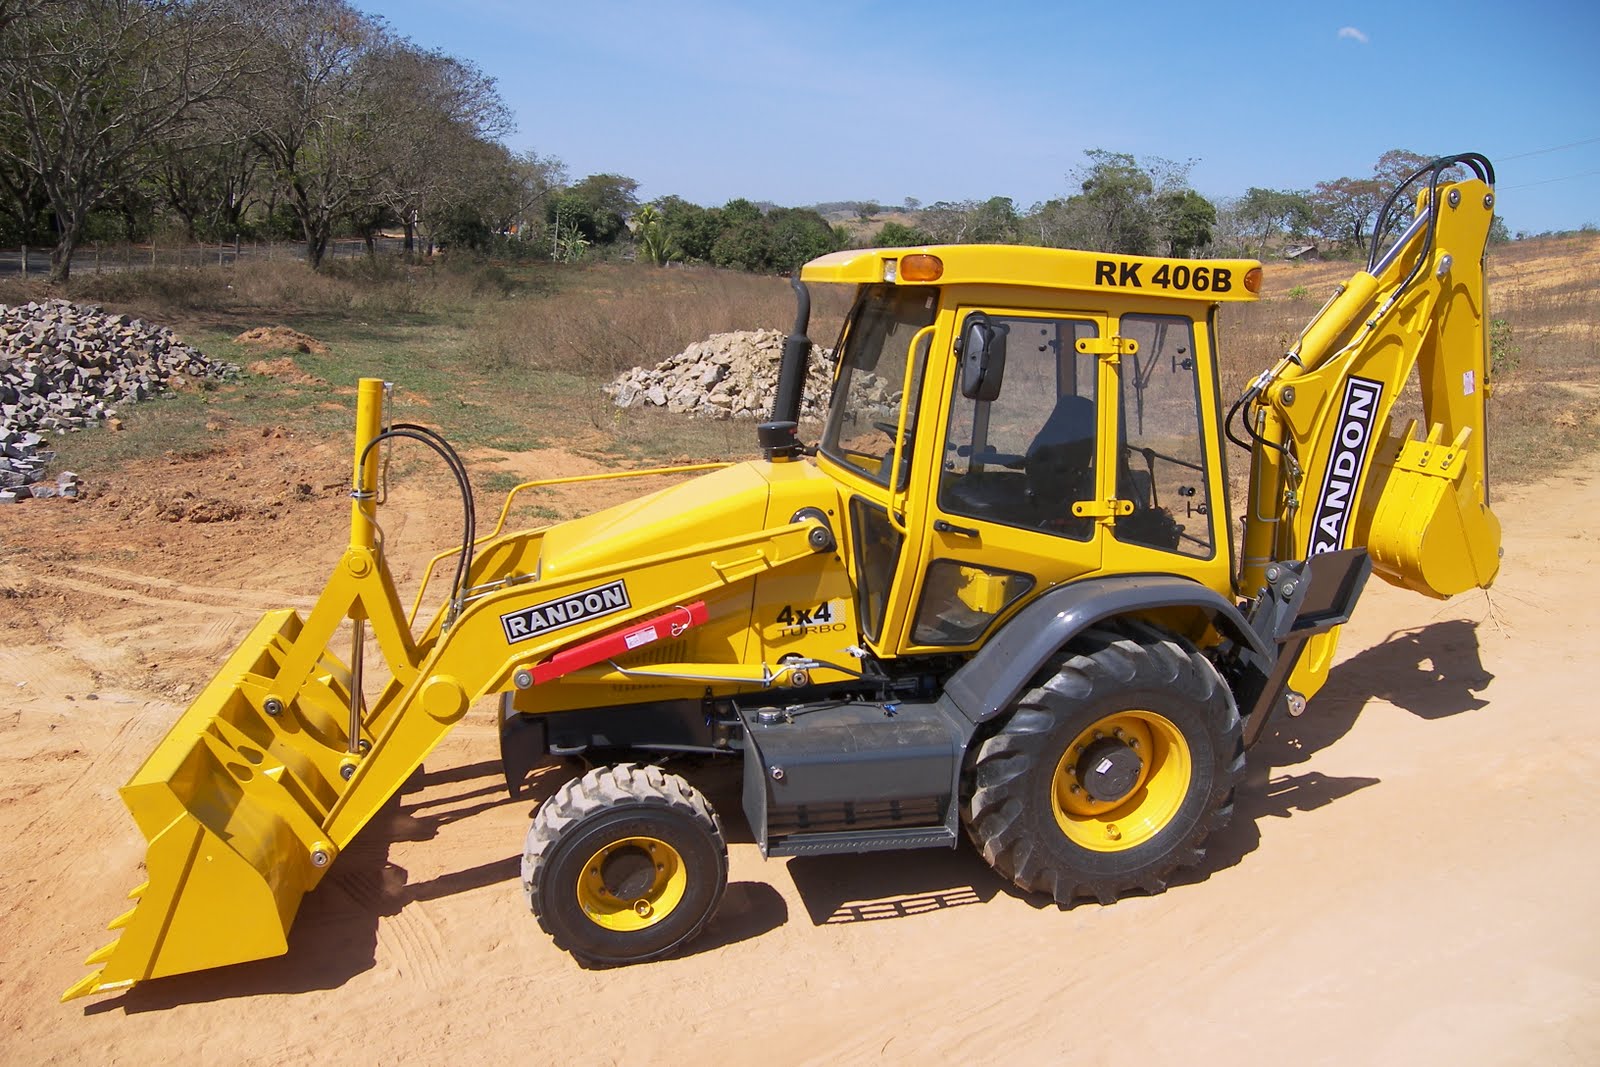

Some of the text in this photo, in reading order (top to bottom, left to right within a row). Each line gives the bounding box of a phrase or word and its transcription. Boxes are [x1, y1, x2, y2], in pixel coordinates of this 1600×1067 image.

[1095, 260, 1232, 293] RK 406B
[507, 585, 624, 638] RANDON
[776, 601, 832, 626] 4x4
[777, 623, 847, 638] TURBO
